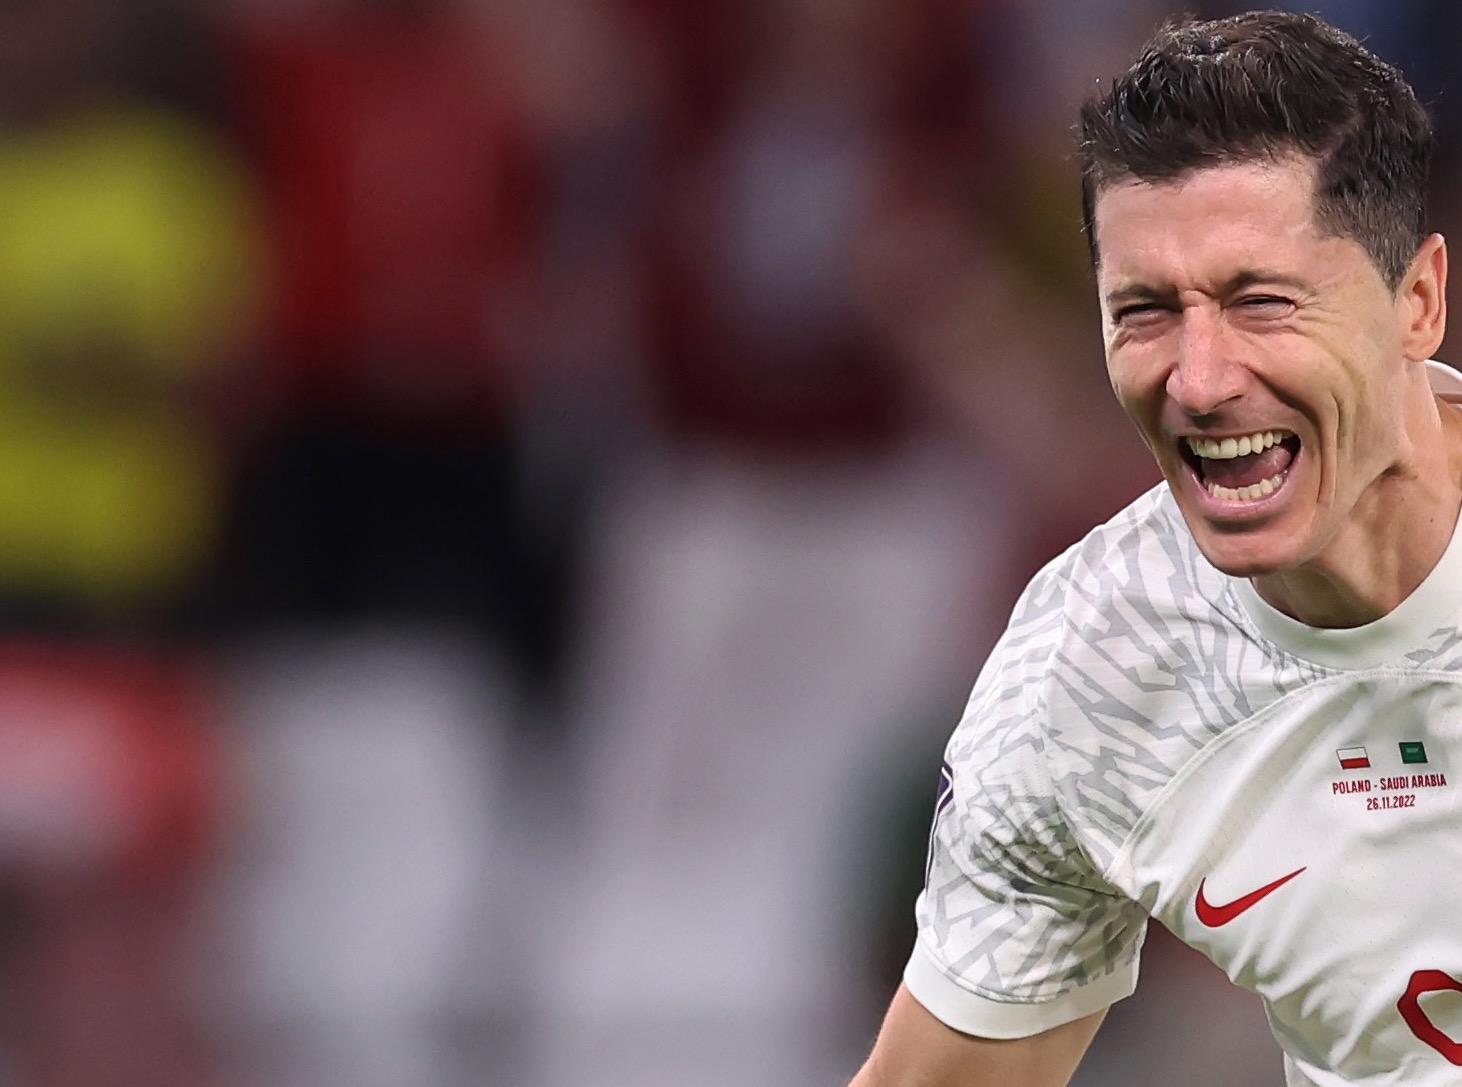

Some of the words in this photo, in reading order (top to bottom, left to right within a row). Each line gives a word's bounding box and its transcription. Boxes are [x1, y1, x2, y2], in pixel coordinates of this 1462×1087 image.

[1332, 780, 1371, 794] POLAND
[1380, 776, 1409, 790] SAUDI
[1411, 774, 1447, 789] ARABIA
[1366, 794, 1416, 811] 26.11.2022
